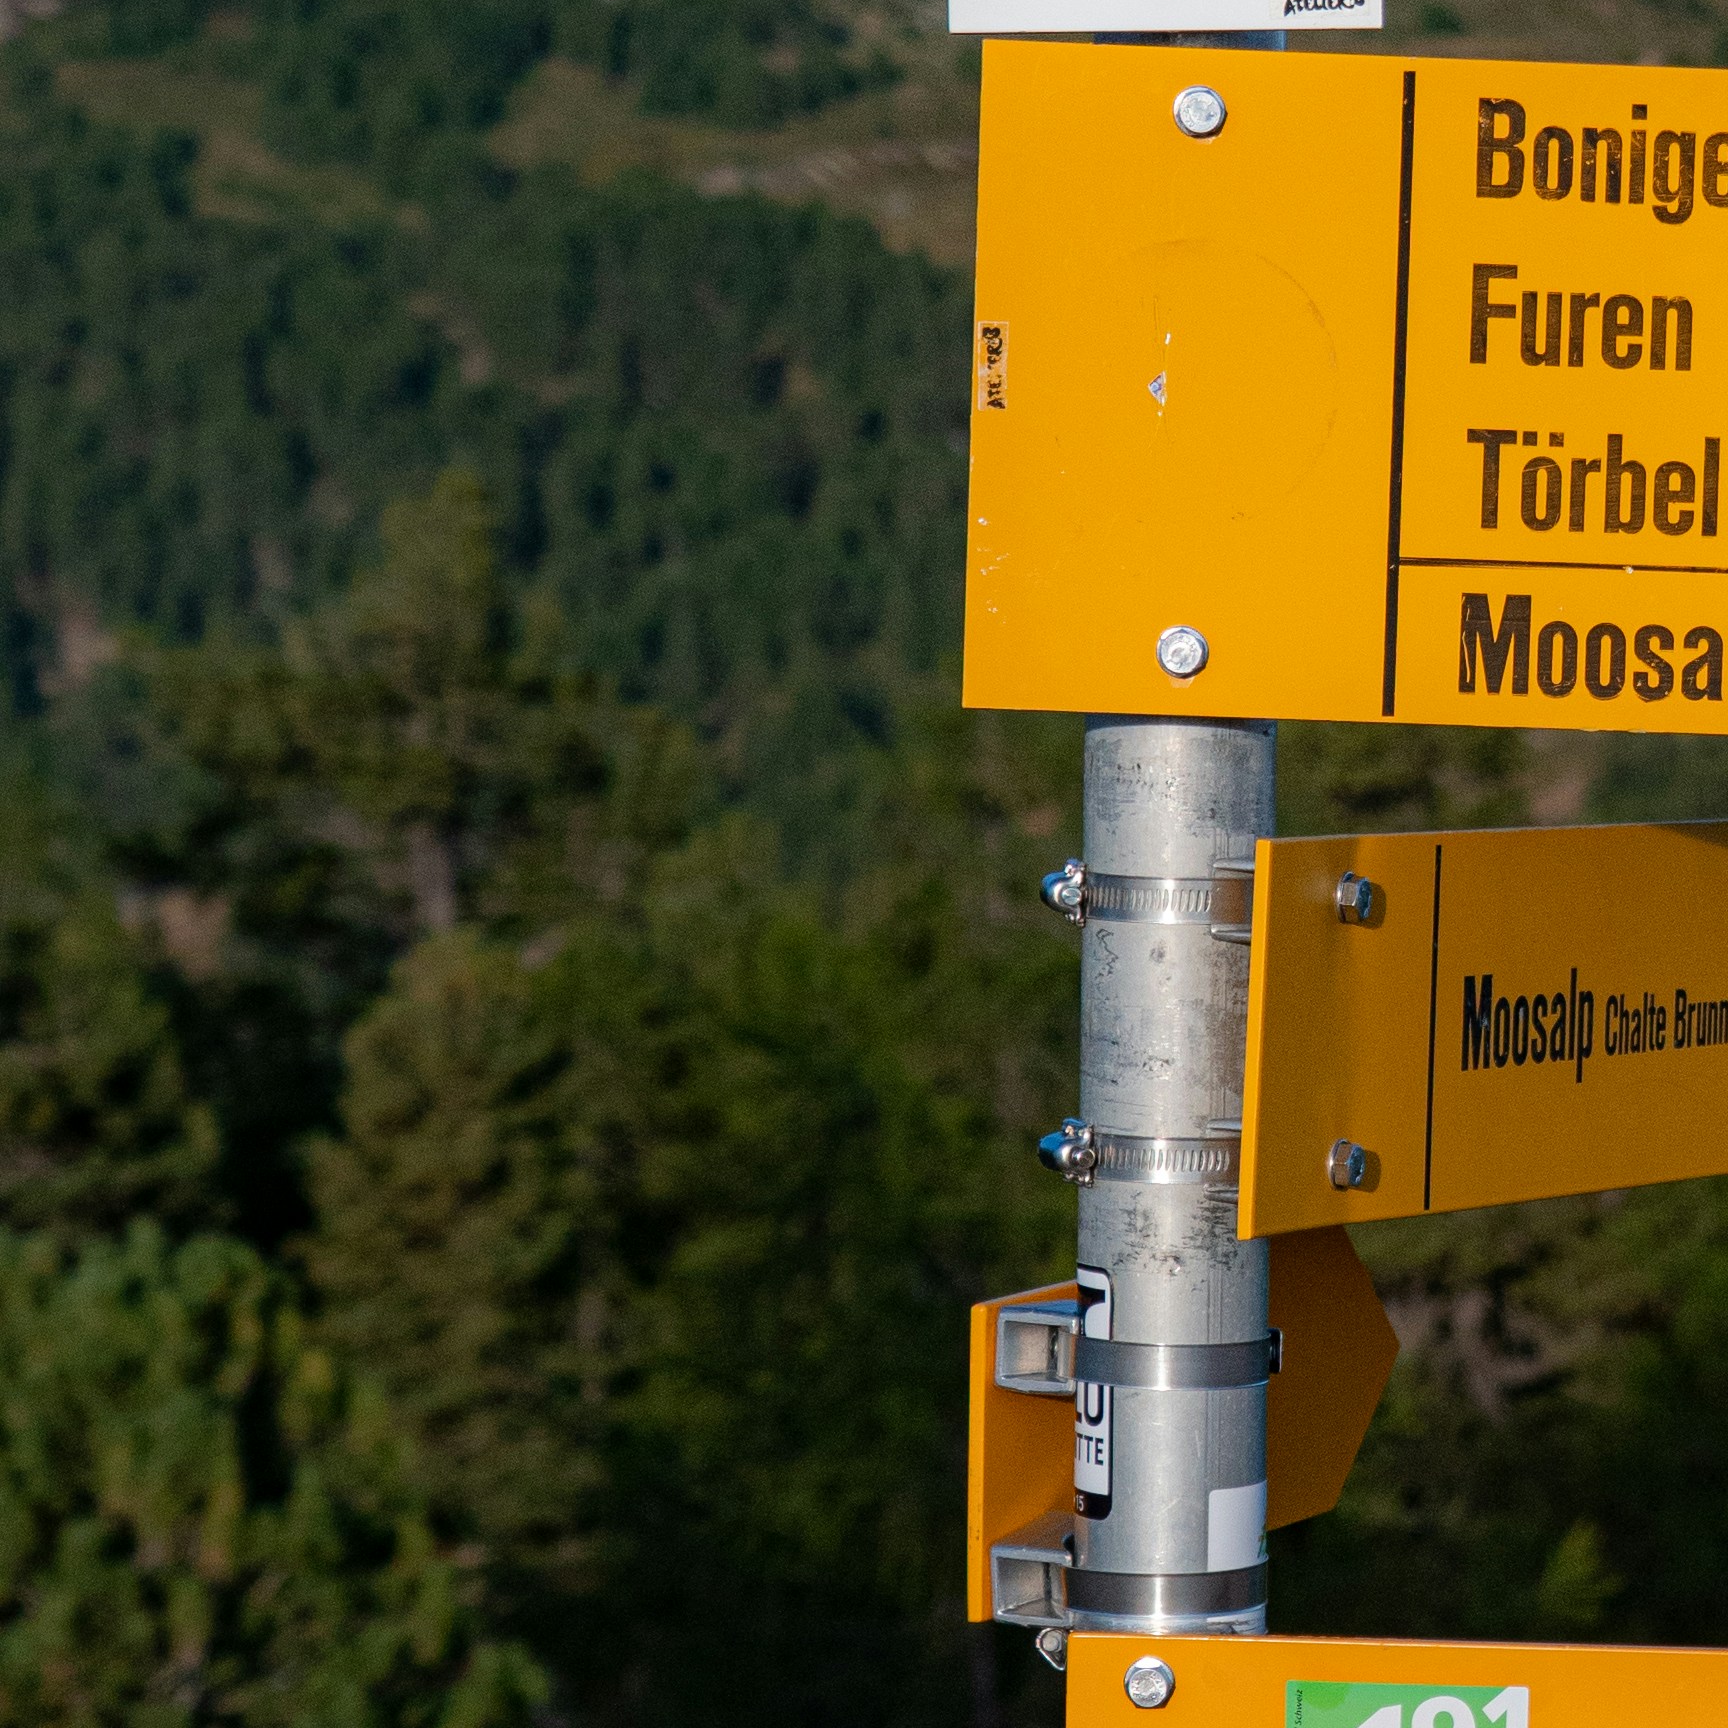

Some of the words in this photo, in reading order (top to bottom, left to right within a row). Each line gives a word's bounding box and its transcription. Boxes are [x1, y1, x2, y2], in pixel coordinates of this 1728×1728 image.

[1469, 263, 1693, 371] Furen
[1466, 428, 1721, 537] Törbel
[1461, 967, 1595, 1084] Moosalp
[1604, 992, 1667, 1057] Chalte
[1294, 1689, 1303, 1726] Schweiz
